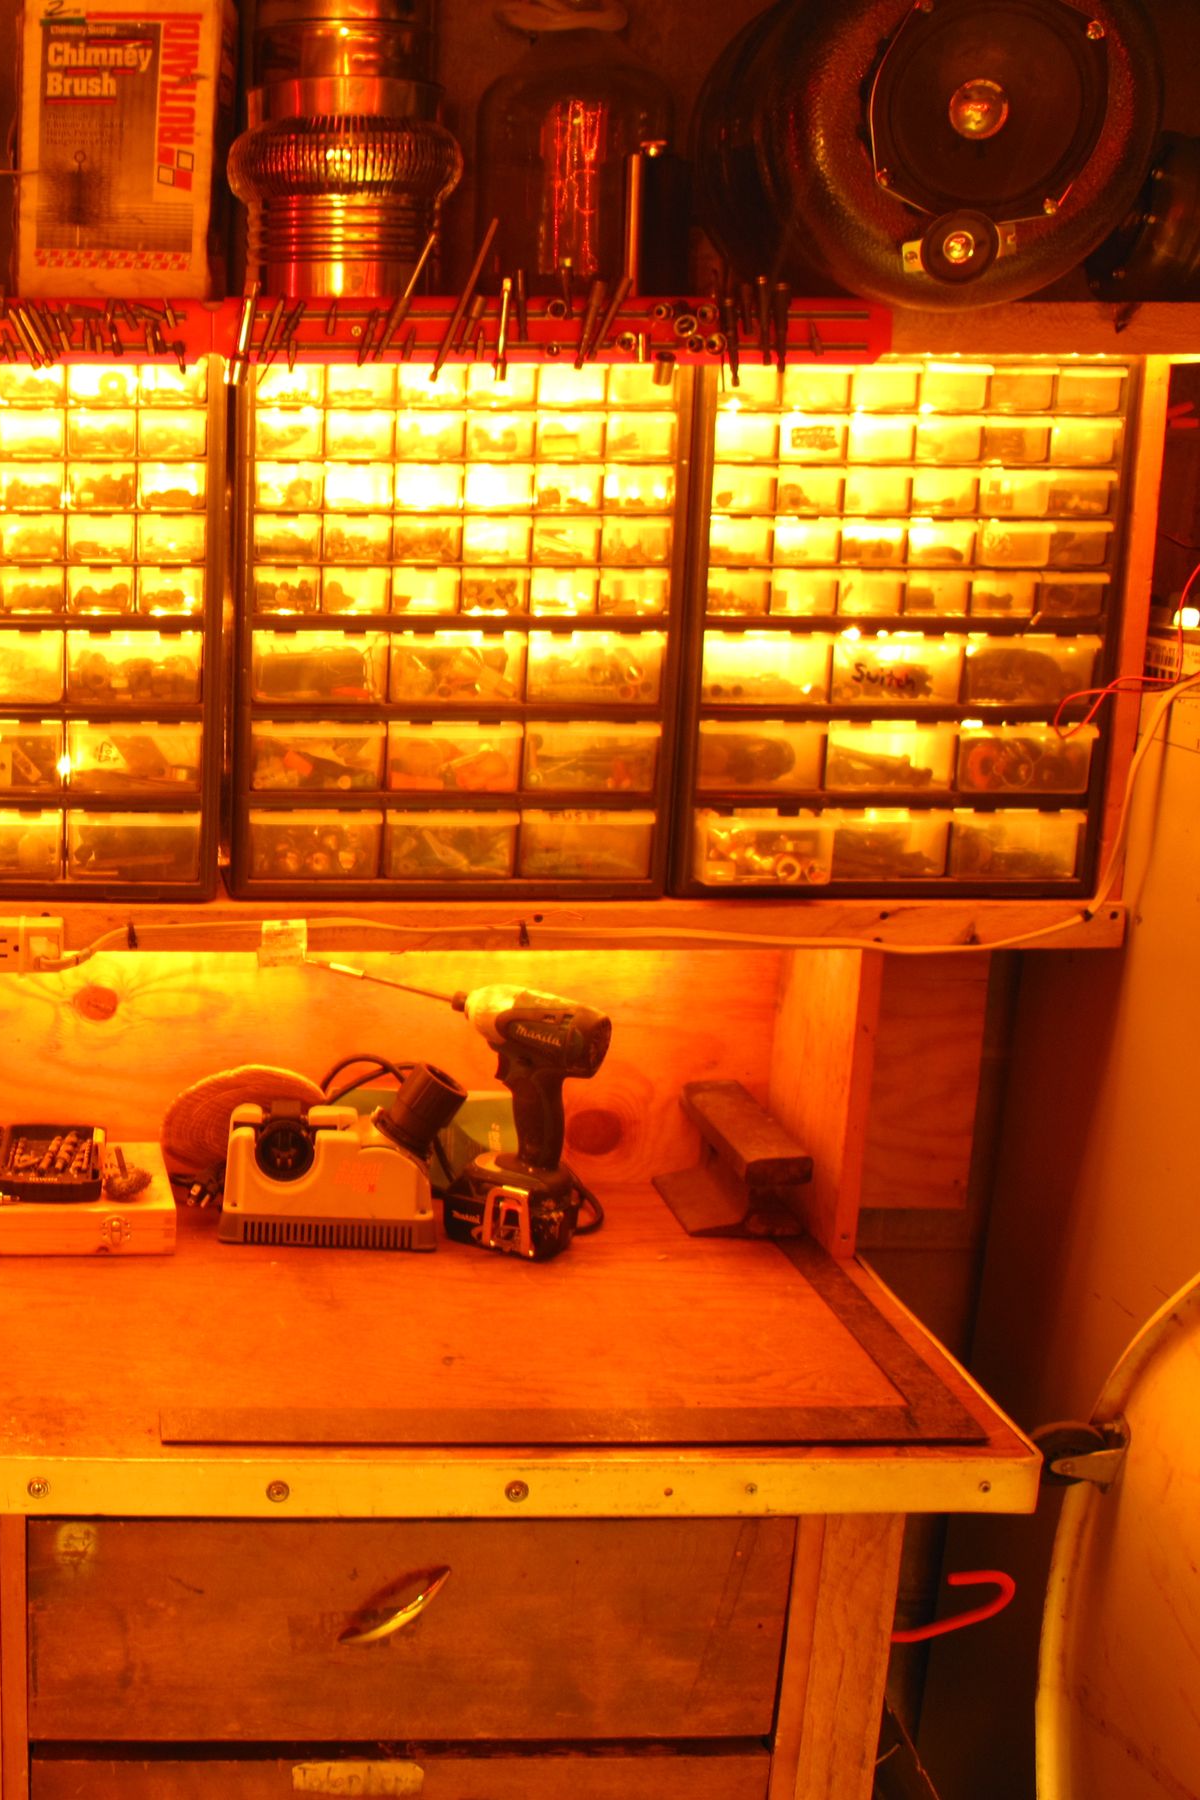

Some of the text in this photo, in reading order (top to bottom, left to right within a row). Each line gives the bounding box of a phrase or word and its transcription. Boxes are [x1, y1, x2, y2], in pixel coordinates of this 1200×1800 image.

[47, 41, 153, 73] Chimney
[46, 72, 117, 96] Brush
[158, 22, 200, 144] RUTLAND
[851, 662, 916, 691] Switch
